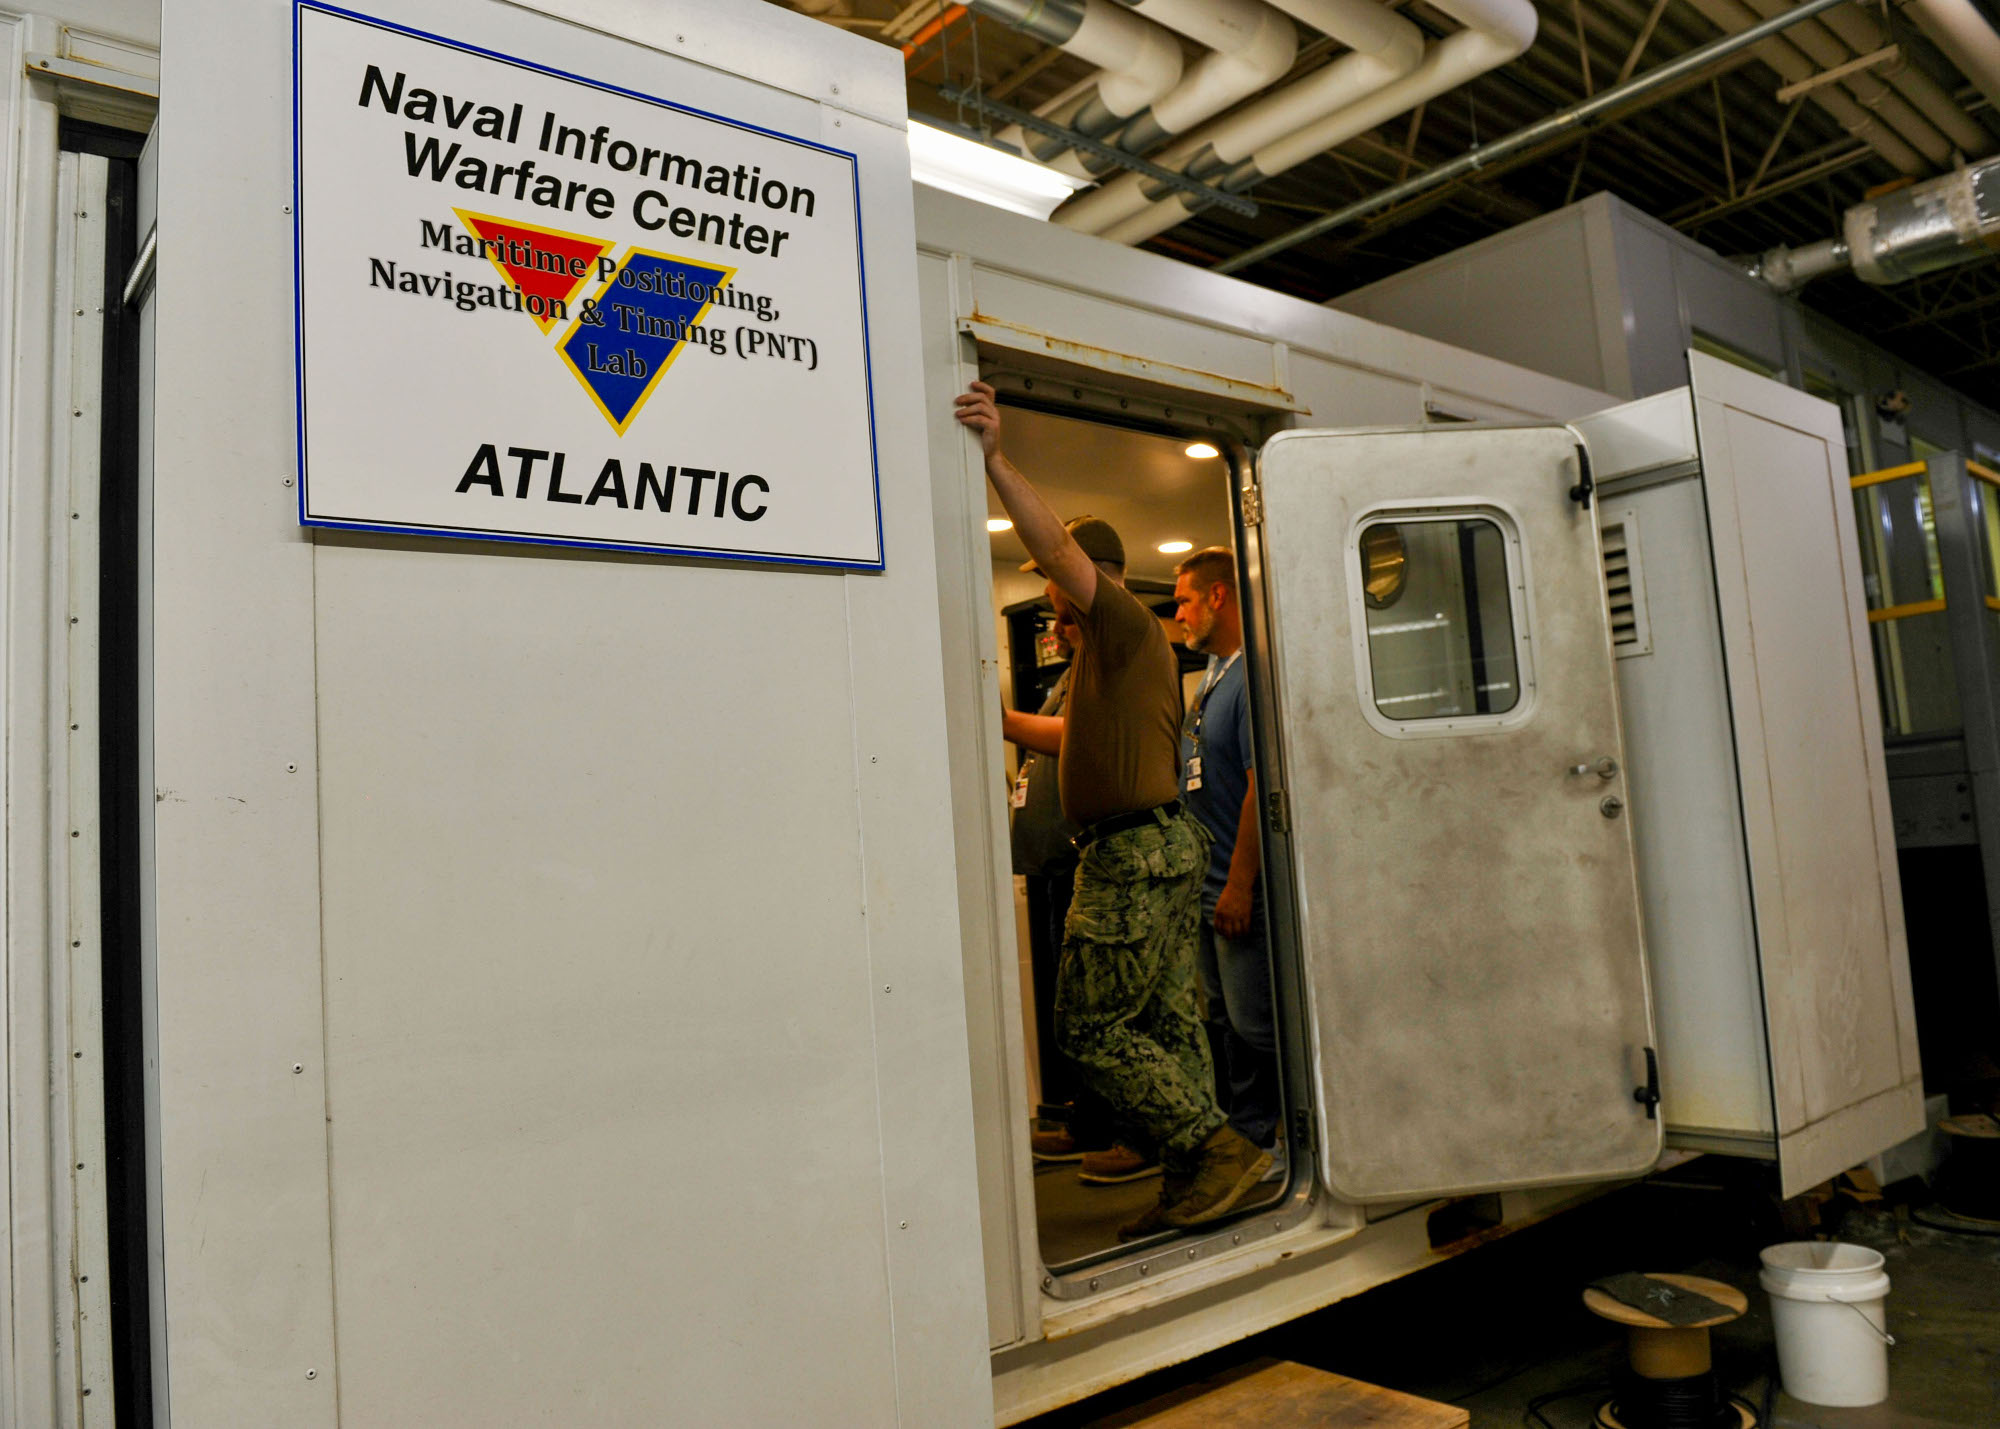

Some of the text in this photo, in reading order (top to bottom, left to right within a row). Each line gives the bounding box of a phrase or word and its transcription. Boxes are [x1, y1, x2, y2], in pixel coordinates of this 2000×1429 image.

[359, 65, 816, 217] Naval Information
[403, 131, 790, 258] Warfare Center
[369, 258, 819, 371] Navigation & Timing (PNT)
[419, 220, 781, 321] Maritime Positioning,
[587, 344, 648, 379] Lab
[455, 443, 770, 522] ATLANTIC
